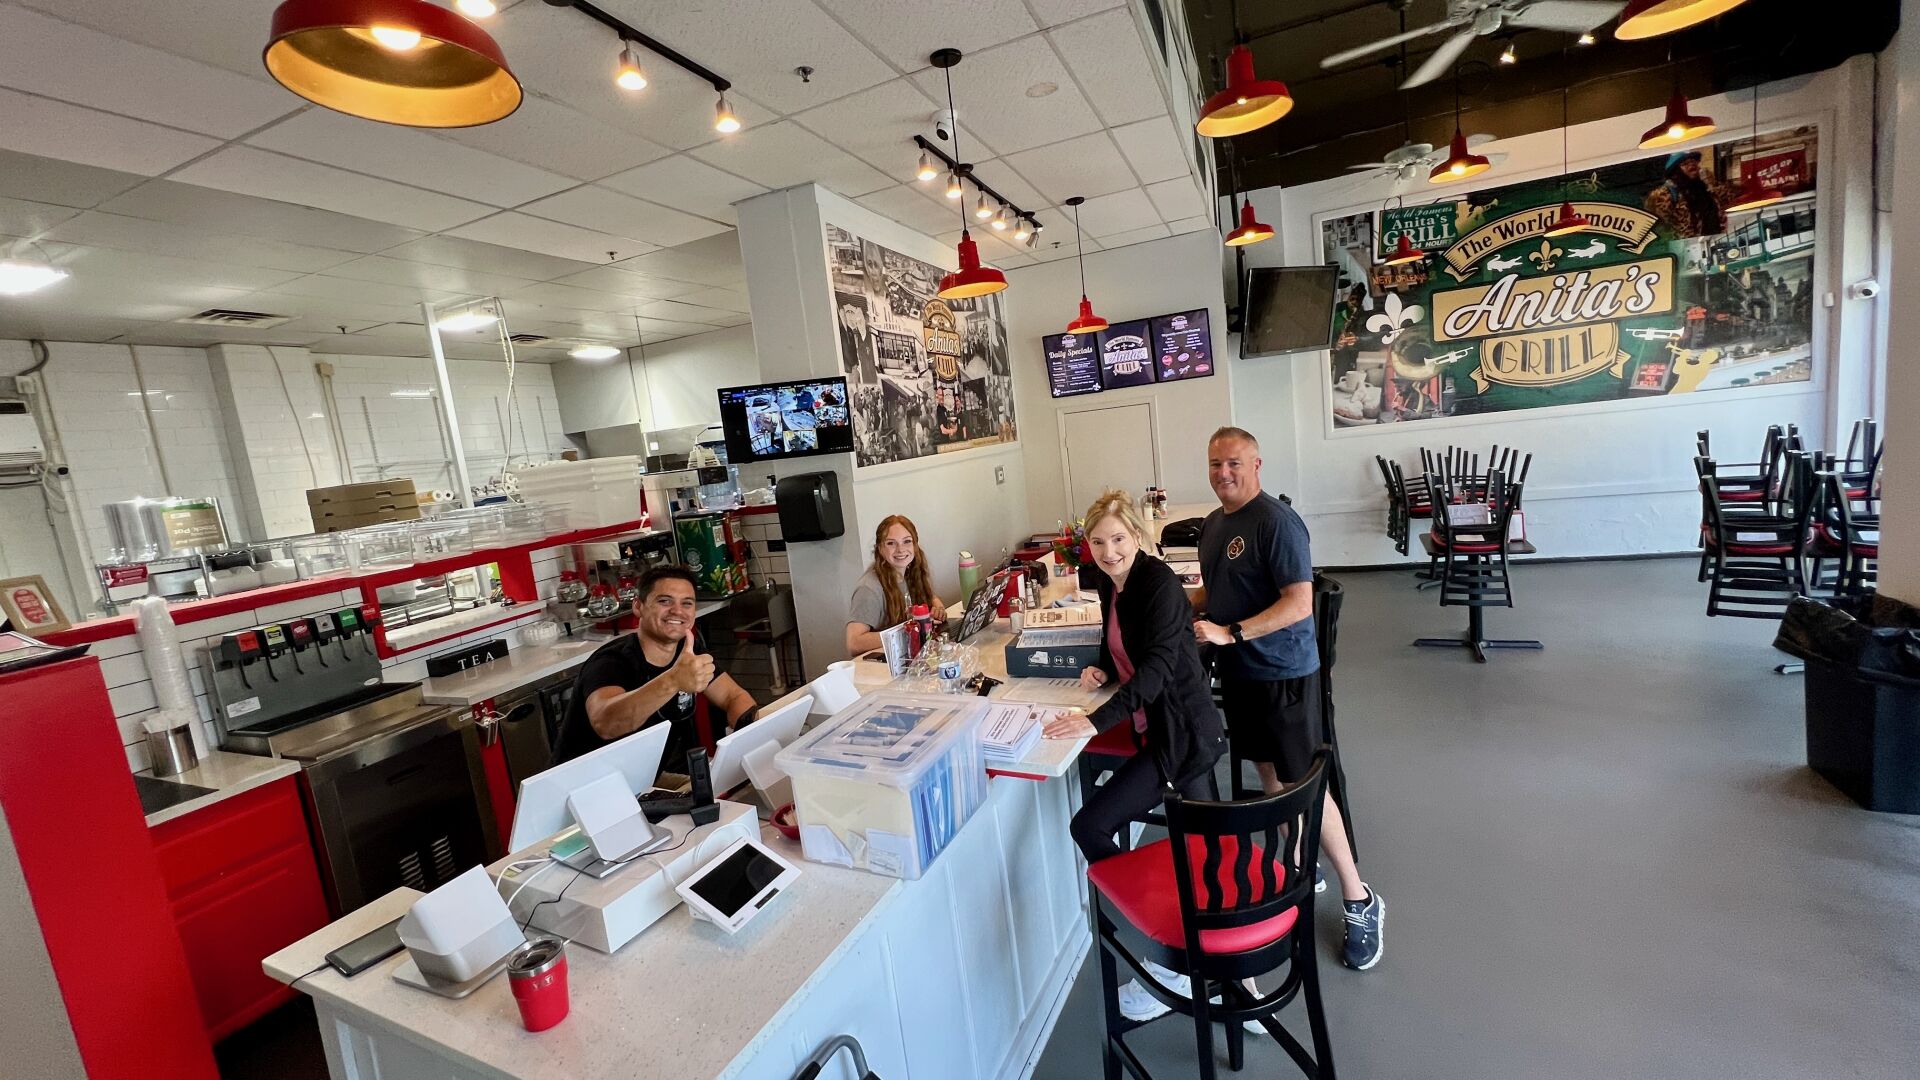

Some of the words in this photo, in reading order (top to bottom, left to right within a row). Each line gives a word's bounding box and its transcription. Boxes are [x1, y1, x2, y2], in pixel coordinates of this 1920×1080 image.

[1391, 213, 1448, 230] Anita's
[1383, 223, 1456, 247] GRILL
[1458, 234, 1493, 261] The
[1493, 211, 1555, 241] World
[1372, 275, 1392, 285] NEW
[1443, 265, 1661, 338] Anita's
[1049, 351, 1066, 359] Daily
[1067, 346, 1093, 357] Specials
[1492, 328, 1605, 376] GRILL
[458, 651, 494, 670] TEA
